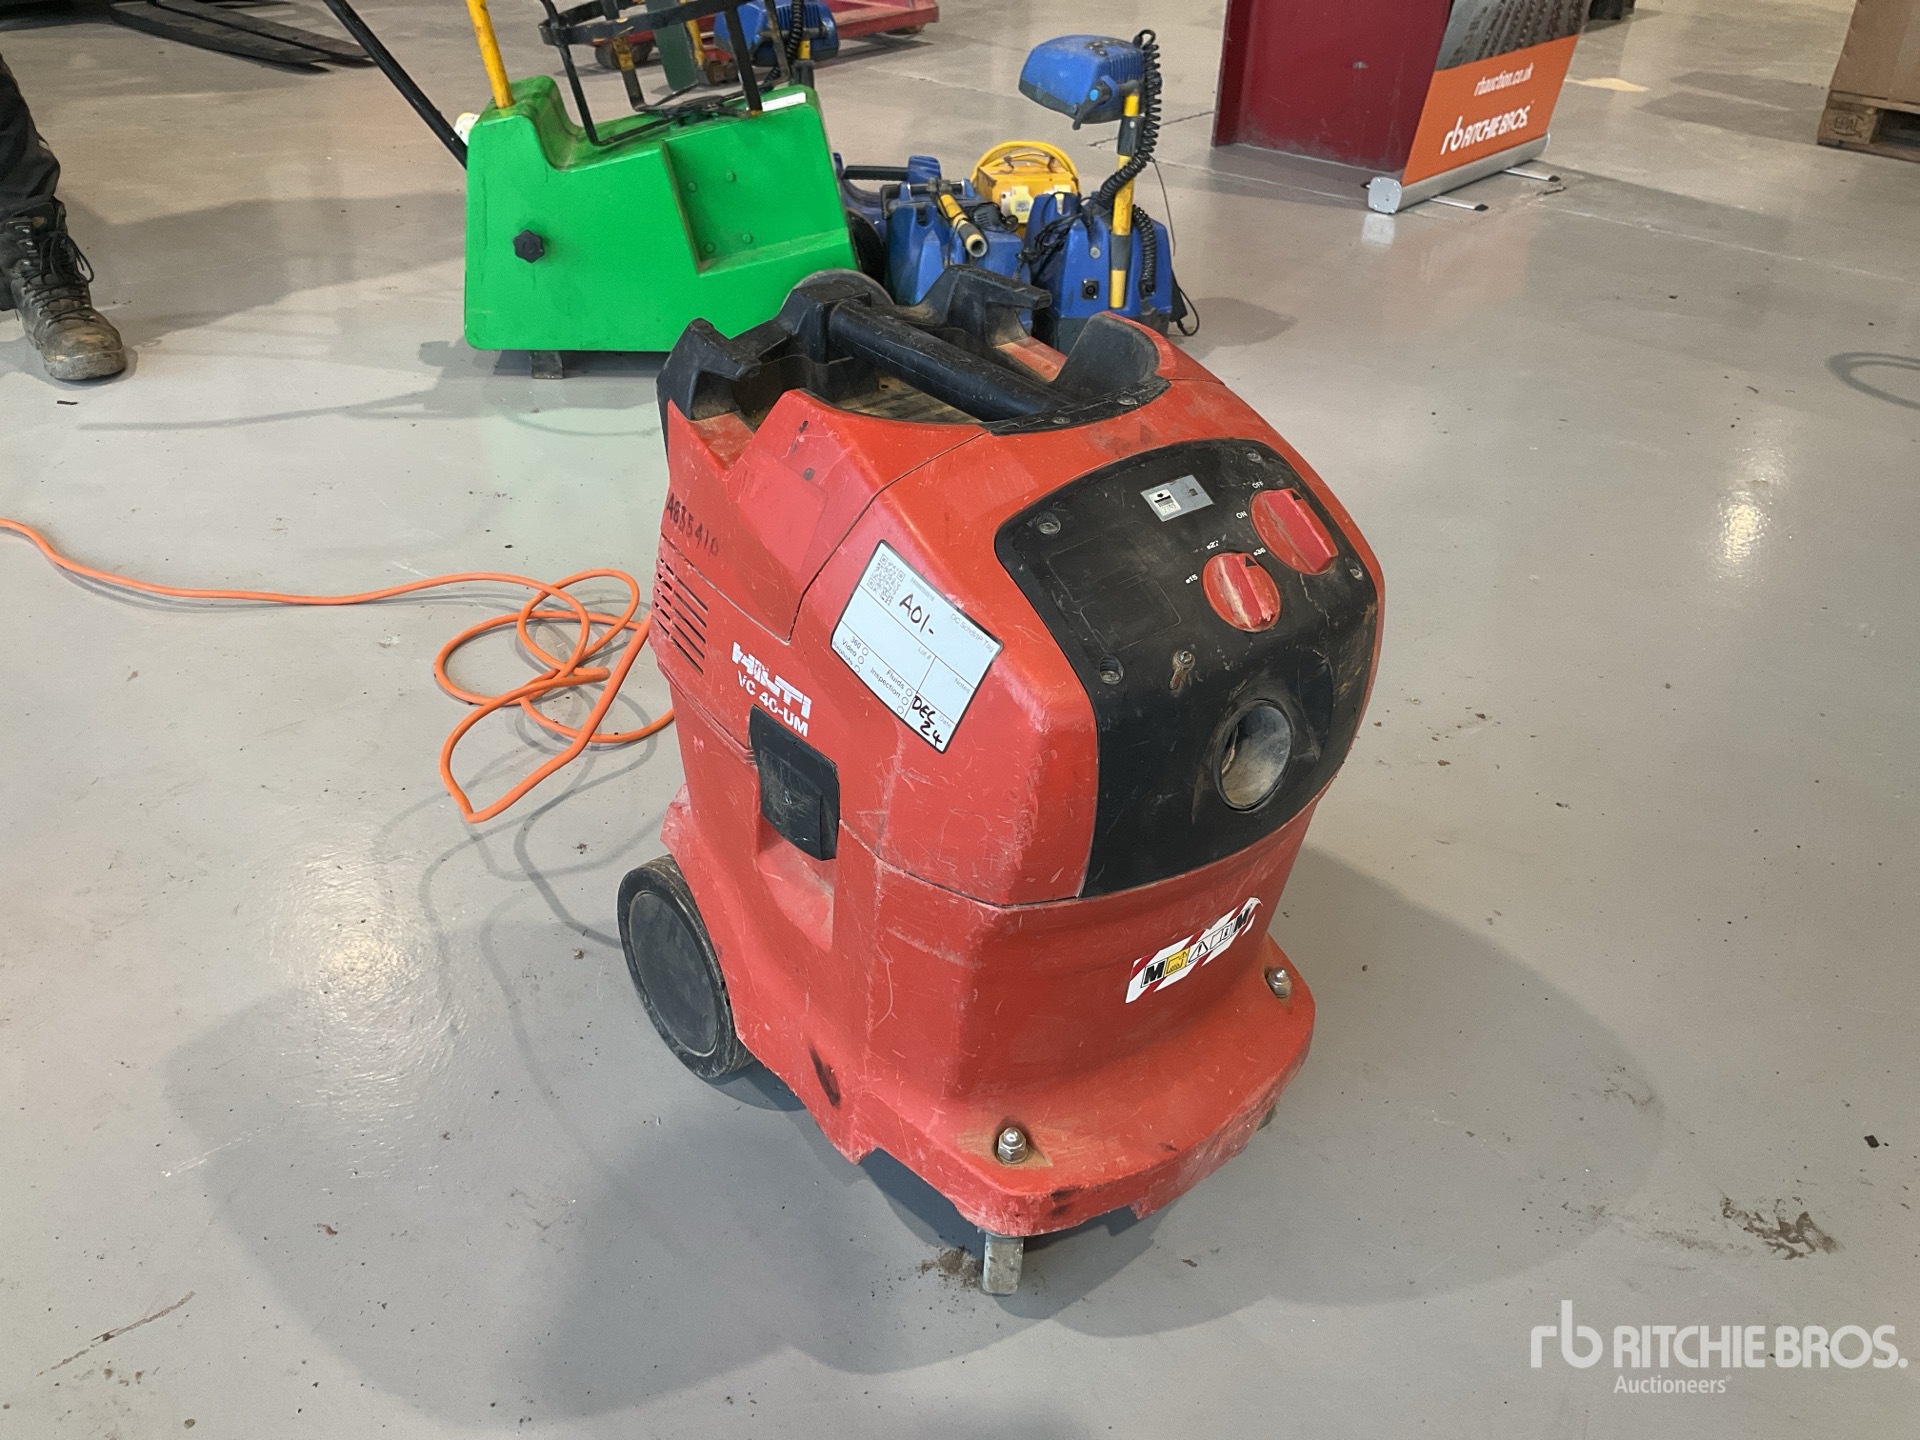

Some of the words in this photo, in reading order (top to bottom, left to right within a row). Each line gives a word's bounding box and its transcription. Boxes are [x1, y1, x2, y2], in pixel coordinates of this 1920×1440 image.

[1440, 116, 1464, 155] rb
[1461, 116, 1501, 148] RITCHIE
[1236, 511, 1248, 519] ON
[842, 638, 857, 657] Video
[851, 636, 862, 649] 360
[918, 647, 928, 657] Lot
[732, 641, 812, 720] HILTI
[870, 668, 901, 698] Inspection
[886, 670, 905, 690] Fluids
[954, 678, 970, 694] Notes
[912, 695, 936, 726] DEC
[920, 721, 943, 747] 24
[1143, 961, 1166, 985] M
